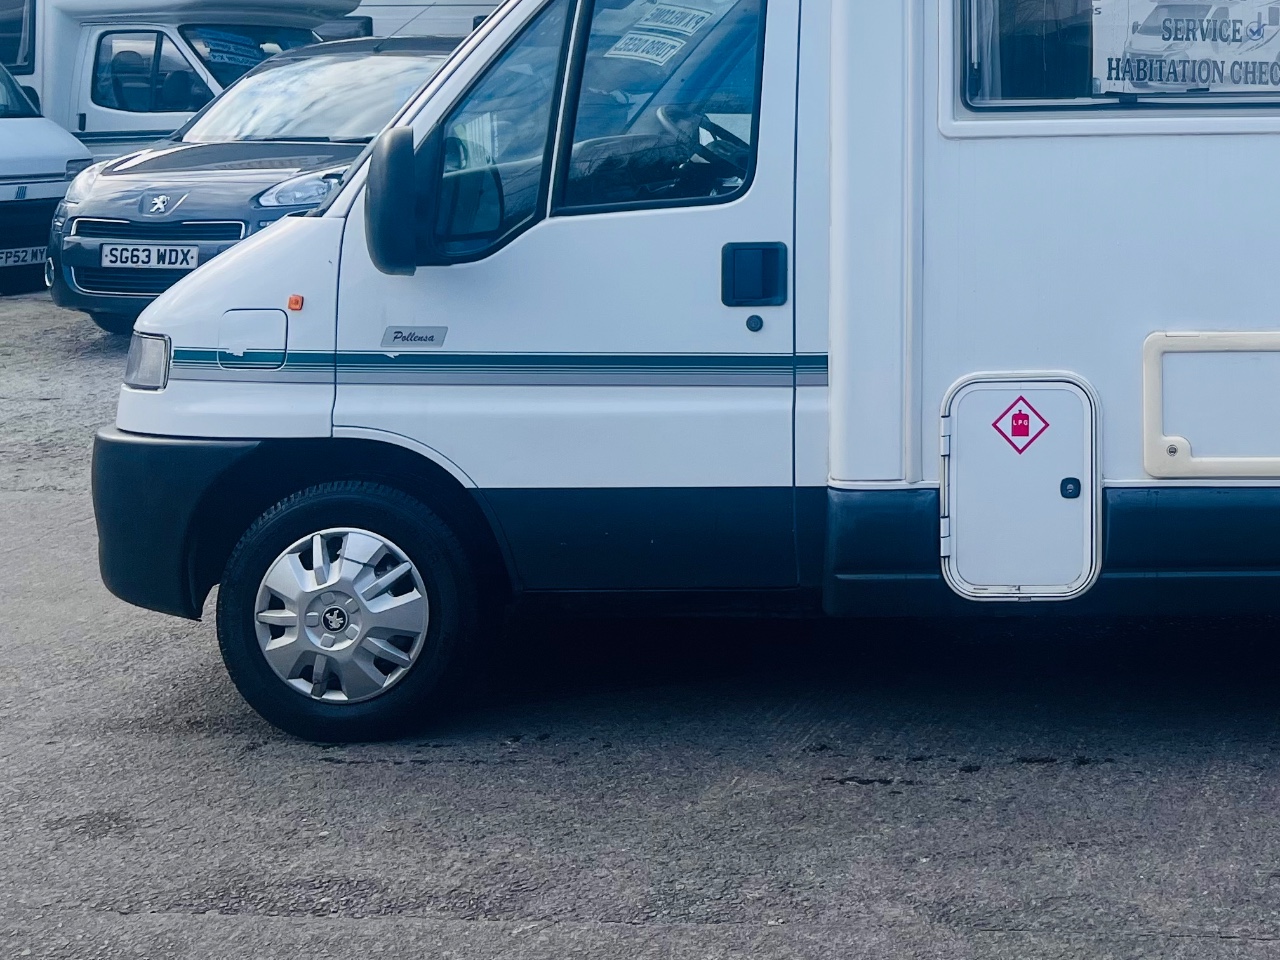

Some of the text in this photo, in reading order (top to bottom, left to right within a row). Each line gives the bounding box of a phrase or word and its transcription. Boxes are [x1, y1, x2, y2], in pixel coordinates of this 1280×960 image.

[1161, 18, 1243, 43] SERVICE
[1106, 57, 1225, 84] HABITATION
[109, 247, 191, 266] SG63 WDX
[393, 330, 436, 343] Pollensa
